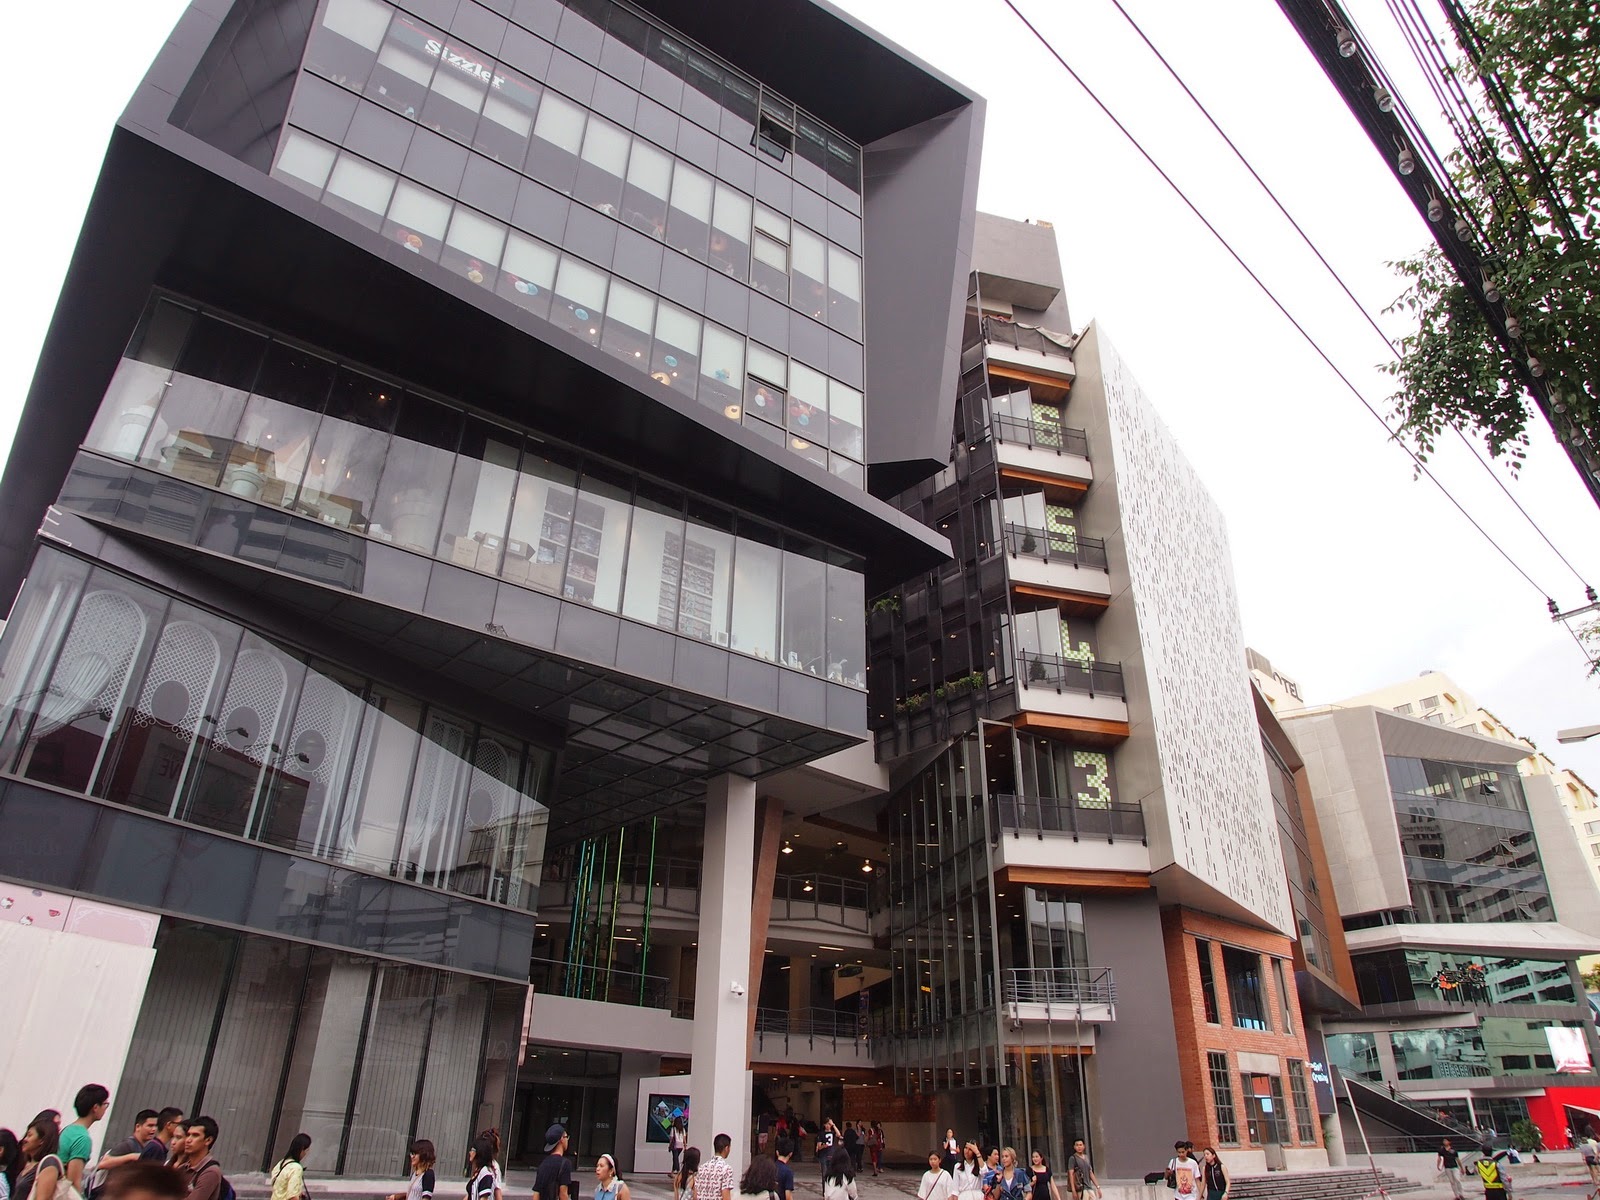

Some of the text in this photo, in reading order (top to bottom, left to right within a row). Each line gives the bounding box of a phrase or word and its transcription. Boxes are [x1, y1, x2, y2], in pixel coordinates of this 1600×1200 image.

[425, 39, 505, 87] Sizzler
[1032, 401, 1063, 447] 6
[1045, 503, 1078, 553] 5
[1060, 619, 1095, 673] 4
[1073, 751, 1112, 809] 3
[825, 1133, 834, 1147] 3
